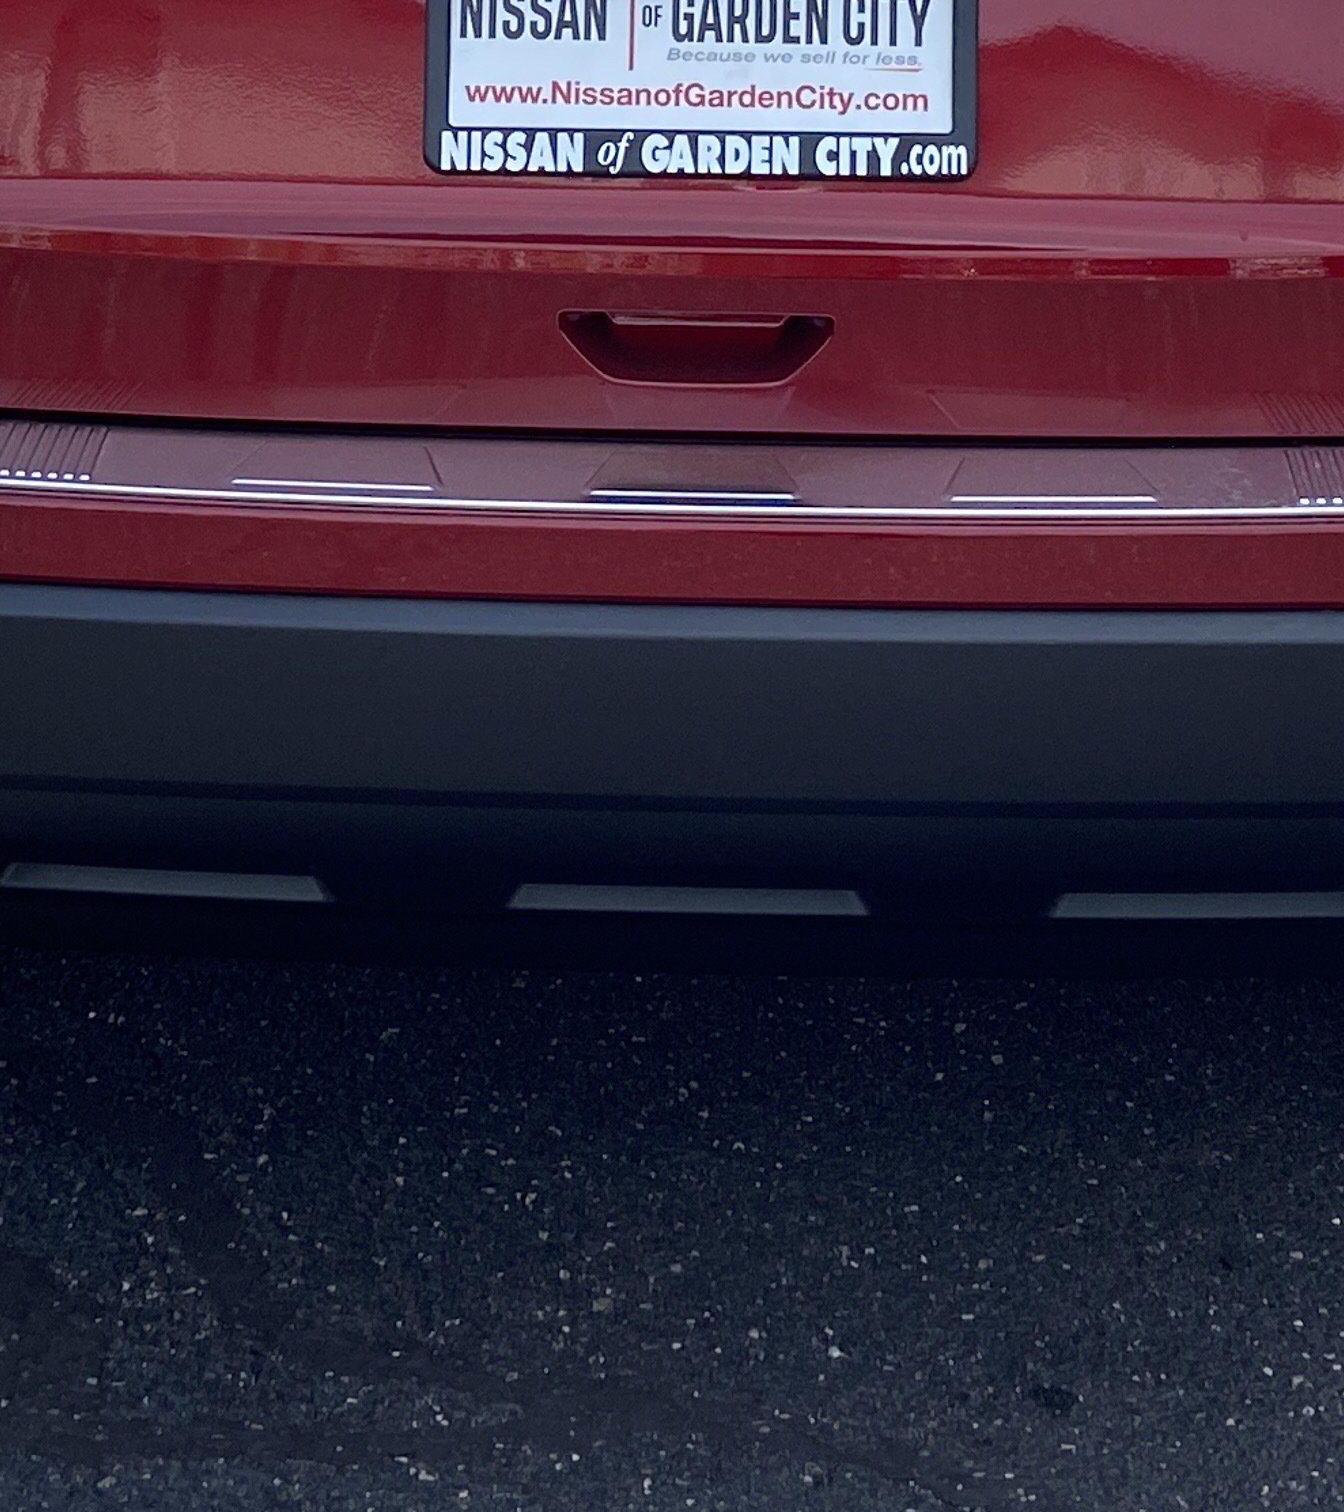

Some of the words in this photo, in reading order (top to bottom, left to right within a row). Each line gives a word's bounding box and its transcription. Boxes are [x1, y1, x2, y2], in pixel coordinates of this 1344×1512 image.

[641, 4, 664, 28] OF
[666, 46, 757, 64] Because
[763, 51, 793, 65] we
[800, 50, 837, 65] sell
[841, 50, 869, 66] for
[875, 51, 923, 67] less.
[464, 79, 929, 116] www.NissanofGardenCity.com
[440, 129, 585, 173] NISSAN
[597, 131, 635, 175] of
[640, 132, 800, 176] GARDEN
[815, 135, 969, 177] CITY.com
